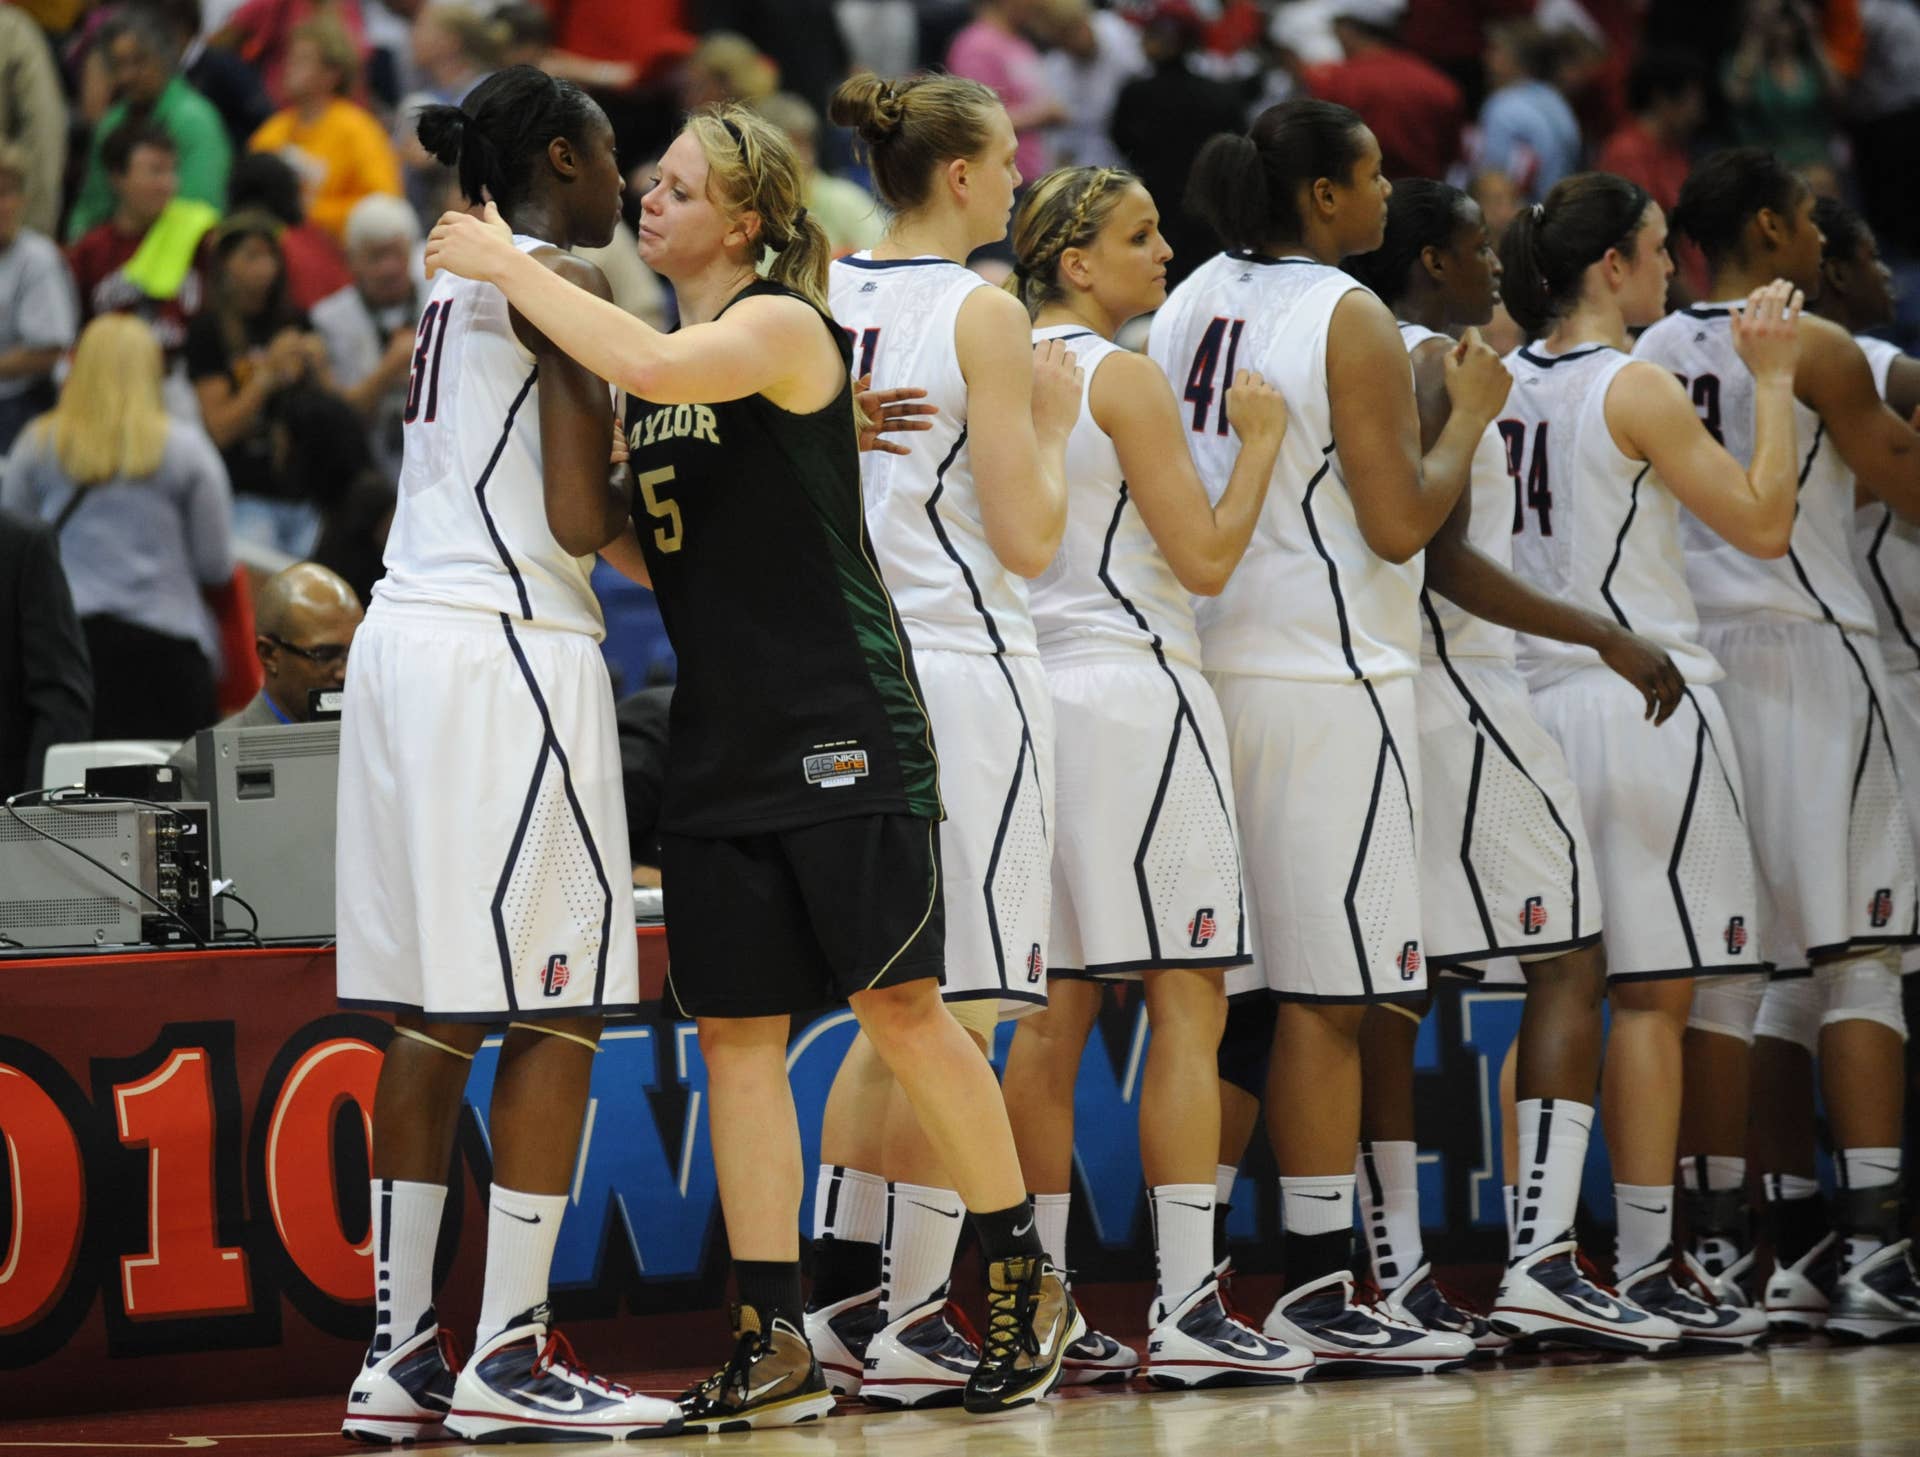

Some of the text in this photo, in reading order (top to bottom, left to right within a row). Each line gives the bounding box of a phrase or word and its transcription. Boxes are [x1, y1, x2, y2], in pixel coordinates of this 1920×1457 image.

[404, 298, 454, 425] 31
[842, 325, 881, 392] 1
[1183, 316, 1246, 436] 41
[1671, 371, 1725, 448] 3
[638, 464, 684, 554] 5
[833, 753, 864, 762] NIKE
[1190, 908, 1215, 948] C
[543, 954, 568, 997] C
